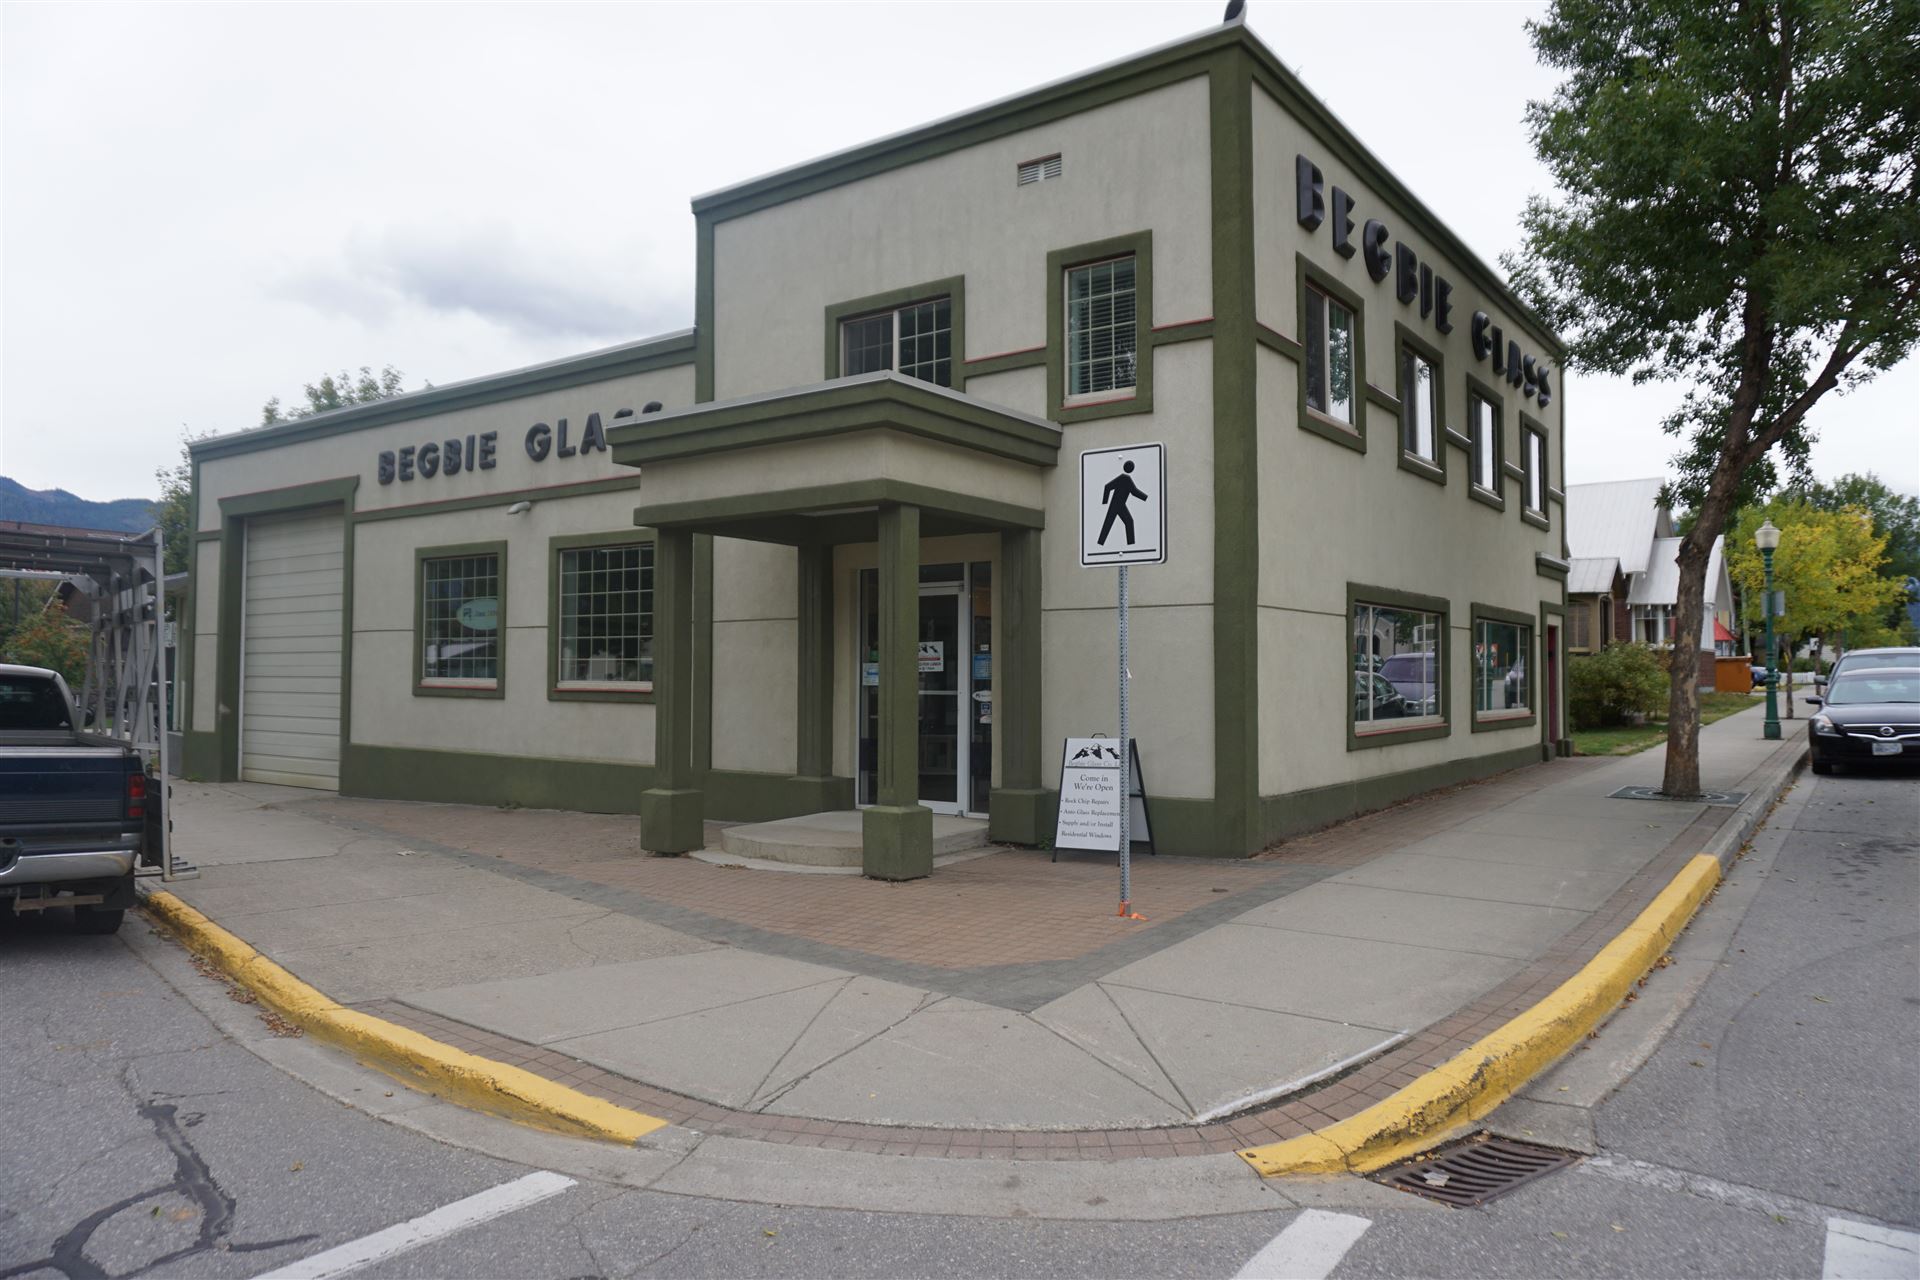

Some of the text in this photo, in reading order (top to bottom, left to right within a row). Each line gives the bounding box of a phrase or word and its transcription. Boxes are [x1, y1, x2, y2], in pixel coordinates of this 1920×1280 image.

[1296, 153, 1551, 409] BEGBIE GLASS
[378, 401, 663, 486] BEGBIE GLA
[1080, 774, 1109, 782] Come in
[1074, 782, 1113, 792] We're Open
[1089, 831, 1112, 839] Windows
